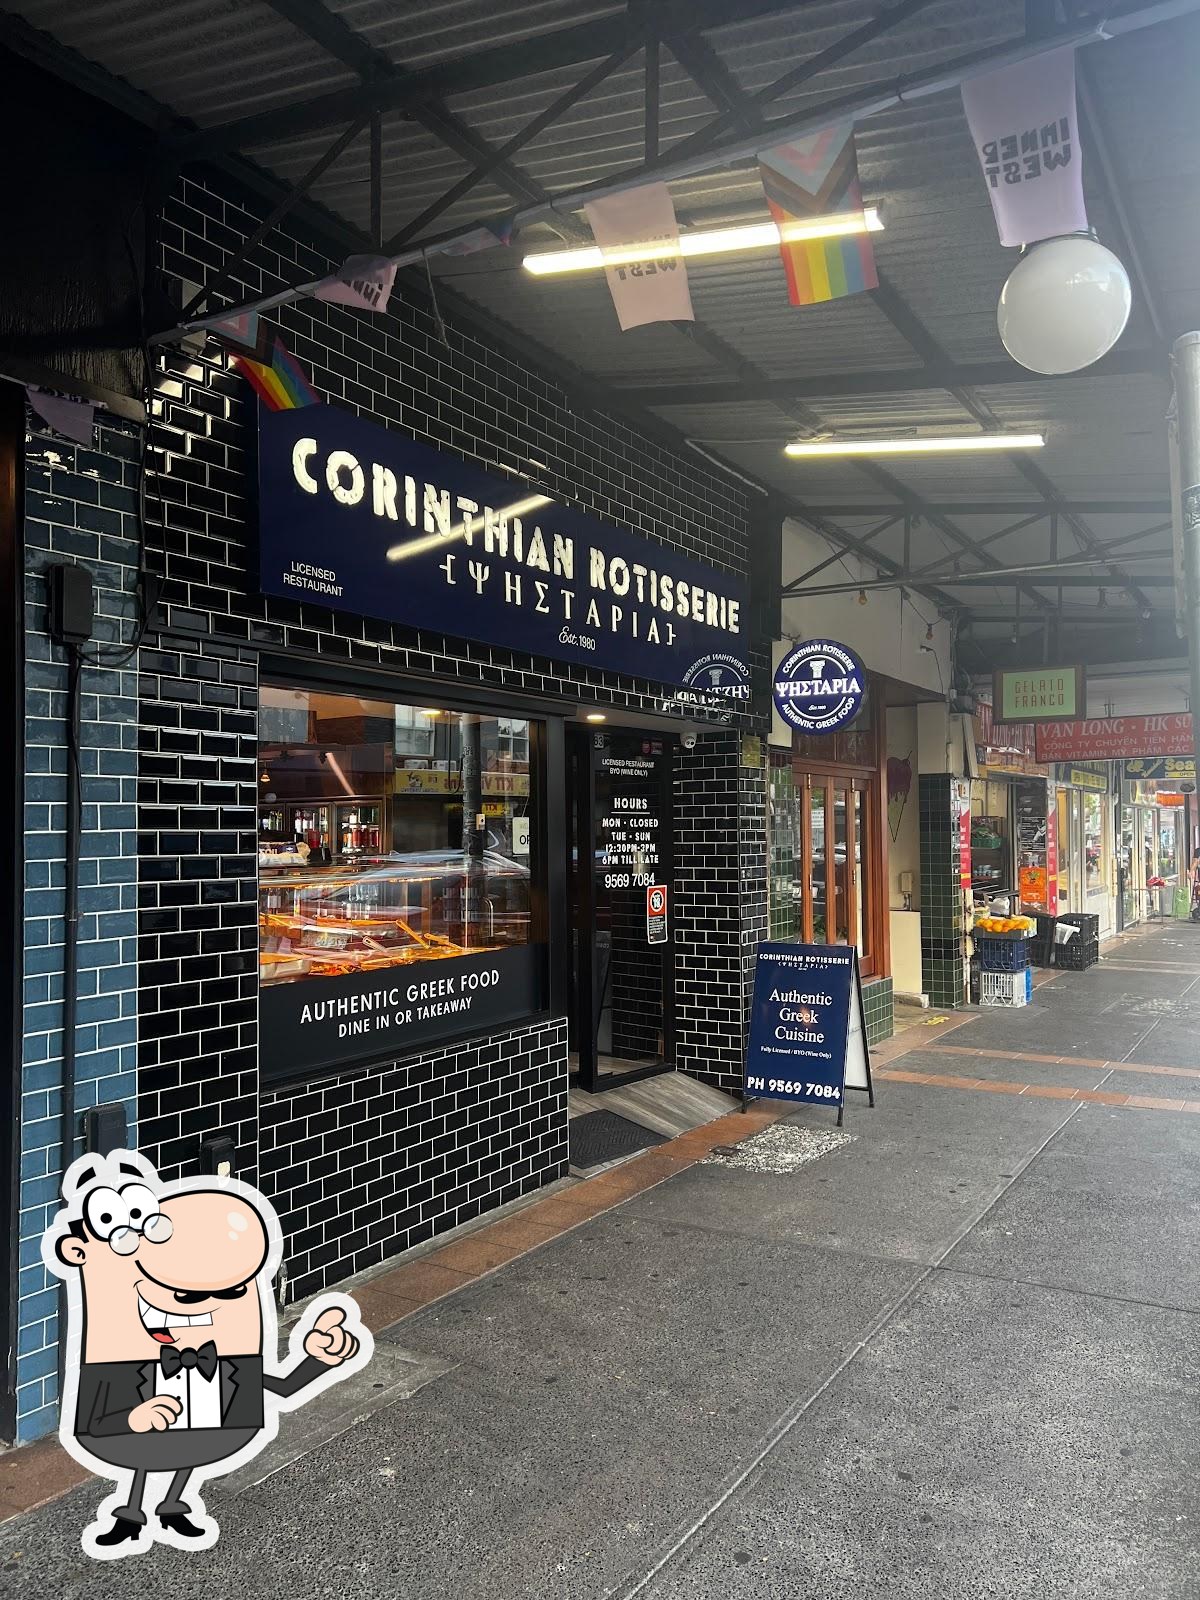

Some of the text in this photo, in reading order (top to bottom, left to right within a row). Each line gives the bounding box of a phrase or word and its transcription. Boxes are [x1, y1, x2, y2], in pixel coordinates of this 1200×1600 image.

[291, 436, 741, 634] CORINTHIAN ROTISSERIE
[291, 560, 336, 582] LICENSED
[283, 572, 344, 597] RESTAURANT
[782, 643, 856, 674] CORINTHIAN ROTISSERIE
[1015, 693, 1064, 709] FRANCO
[781, 697, 855, 729] AUTHENTIC GREEK FOOD
[1081, 718, 1125, 736] LONG
[1143, 716, 1169, 732] HK
[1174, 715, 1193, 729] SU
[1077, 740, 1090, 749] TY
[1171, 731, 1194, 743] HÀN
[601, 758, 655, 769] LICENSED RESTAURANT
[1065, 750, 1107, 760] VITAMIN
[609, 767, 620, 775] BYO
[1164, 758, 1196, 771] Sea
[613, 797, 648, 810] HOURS
[602, 818, 621, 828] MON
[629, 818, 659, 828] CLOSED
[611, 831, 627, 841] TUE
[635, 831, 651, 841] SUN
[602, 854, 659, 865] 6PM TILL LATE
[604, 872, 656, 889] 9569 7084
[759, 953, 850, 965] CORINTHIAN ROTISSERIE
[299, 969, 500, 1024] AUTHENTIC GREEK FOOD
[768, 988, 833, 1006] Authentic
[338, 996, 473, 1038] DINE IN OR TAKEAWAY
[779, 1007, 820, 1024] Greek
[774, 1025, 825, 1044] Cuisine
[760, 1045, 772, 1053] Fully
[772, 1046, 791, 1055] Licensed
[747, 1076, 841, 1100] PH 9569 7084
